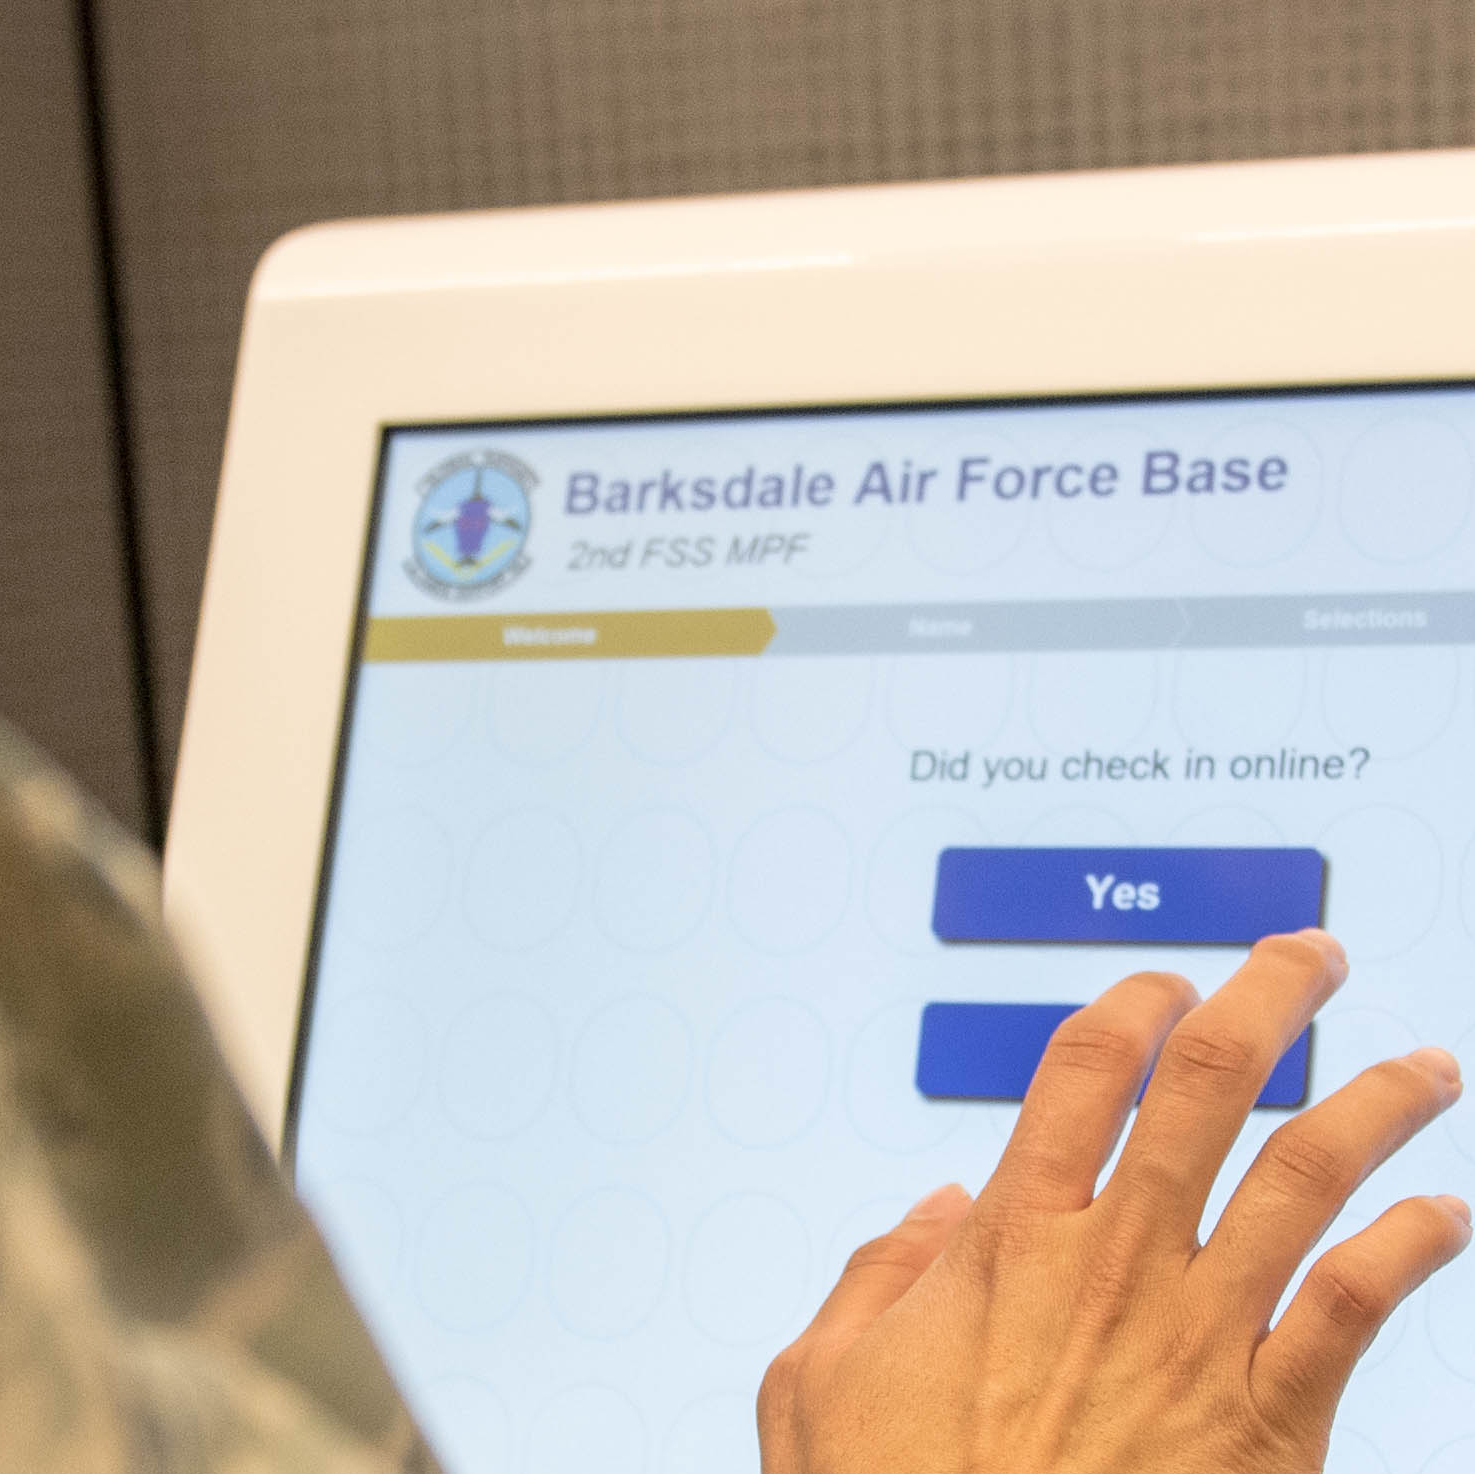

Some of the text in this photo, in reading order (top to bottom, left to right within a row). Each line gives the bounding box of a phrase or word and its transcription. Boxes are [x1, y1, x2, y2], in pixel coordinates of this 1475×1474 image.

[564, 463, 836, 516] Barksdale
[854, 458, 936, 505] Air
[955, 455, 1120, 504] Force
[1140, 450, 1289, 496] Base
[568, 533, 811, 572] 2nd FSS MPF
[1302, 606, 1428, 631] Selections
[910, 747, 1371, 788] Did you check in online?
[1085, 874, 1160, 910] Yes
